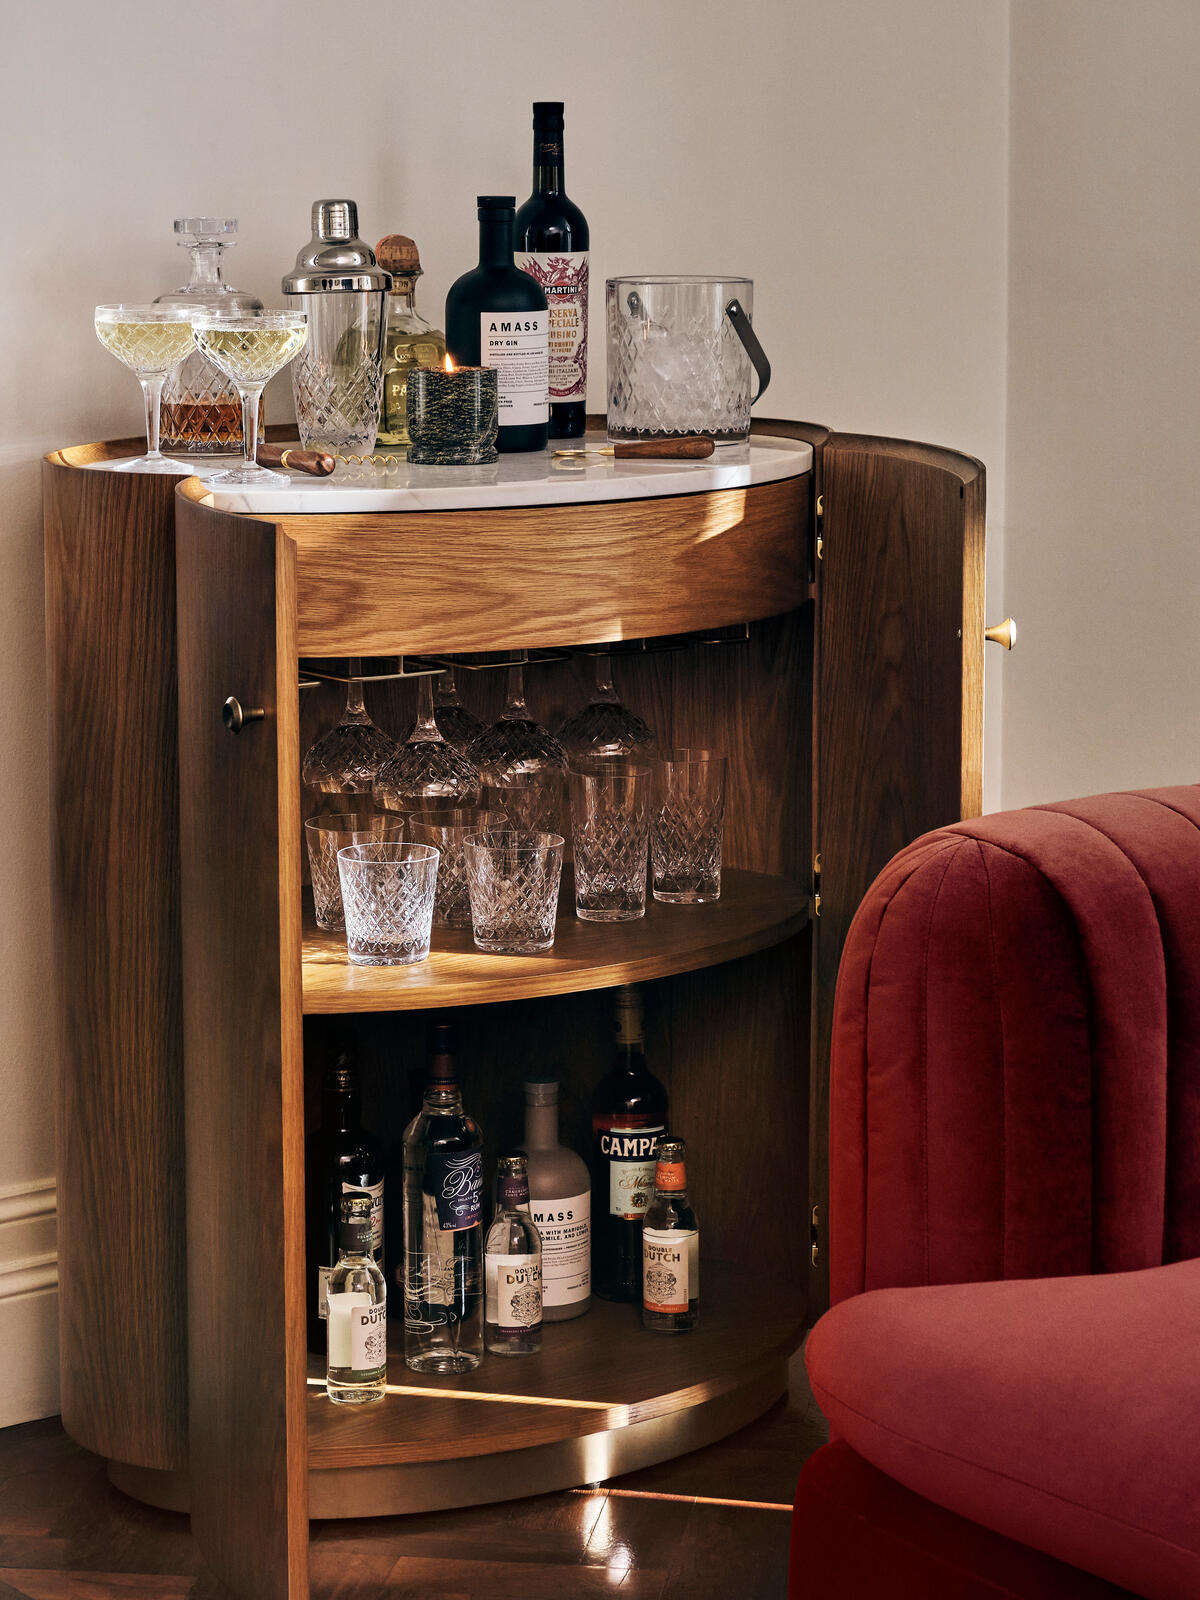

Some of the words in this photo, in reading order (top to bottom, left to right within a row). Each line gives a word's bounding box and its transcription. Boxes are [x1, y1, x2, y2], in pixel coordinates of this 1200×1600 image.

[544, 286, 577, 294] MARTINI
[549, 309, 577, 318] ISERVA
[489, 321, 538, 332] AMASS
[548, 317, 579, 328] PECIALE
[550, 330, 577, 338] UBINO
[601, 1135, 658, 1157] CAMPA
[533, 1211, 574, 1223] MASS
[647, 1244, 673, 1253] DOUBLE
[643, 1247, 681, 1263] DUTCH
[368, 1305, 386, 1315] DOUB
[360, 1310, 386, 1326] DUTC
